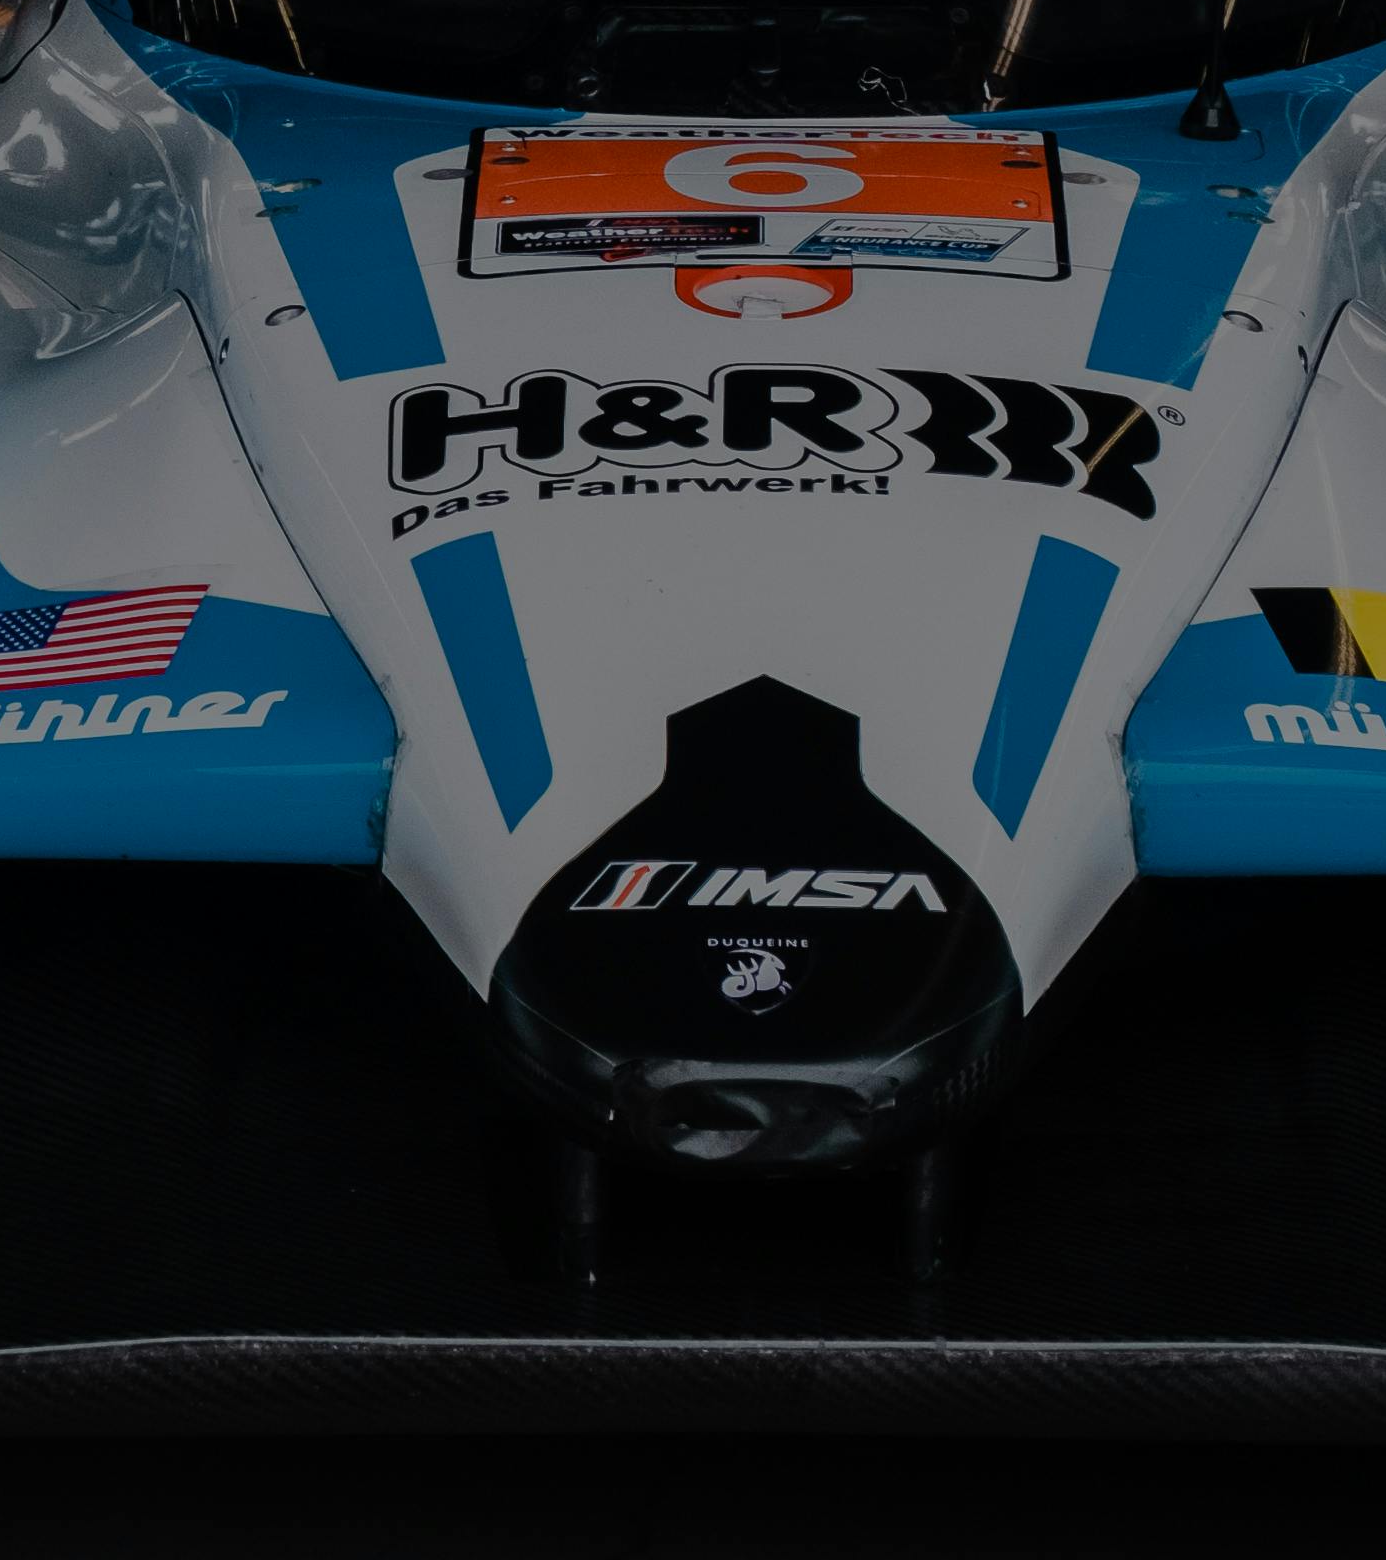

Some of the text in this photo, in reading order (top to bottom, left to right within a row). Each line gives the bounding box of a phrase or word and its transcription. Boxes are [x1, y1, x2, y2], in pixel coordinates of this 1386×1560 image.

[509, 129, 1031, 143] WeatherTech
[663, 143, 865, 208] 6
[820, 235, 989, 250] ENDURANCE CUP
[401, 368, 866, 482] H&R
[392, 475, 891, 540] Das Fahrwerk!
[687, 867, 949, 914] IMSA
[706, 937, 810, 949] DUQUEINE
